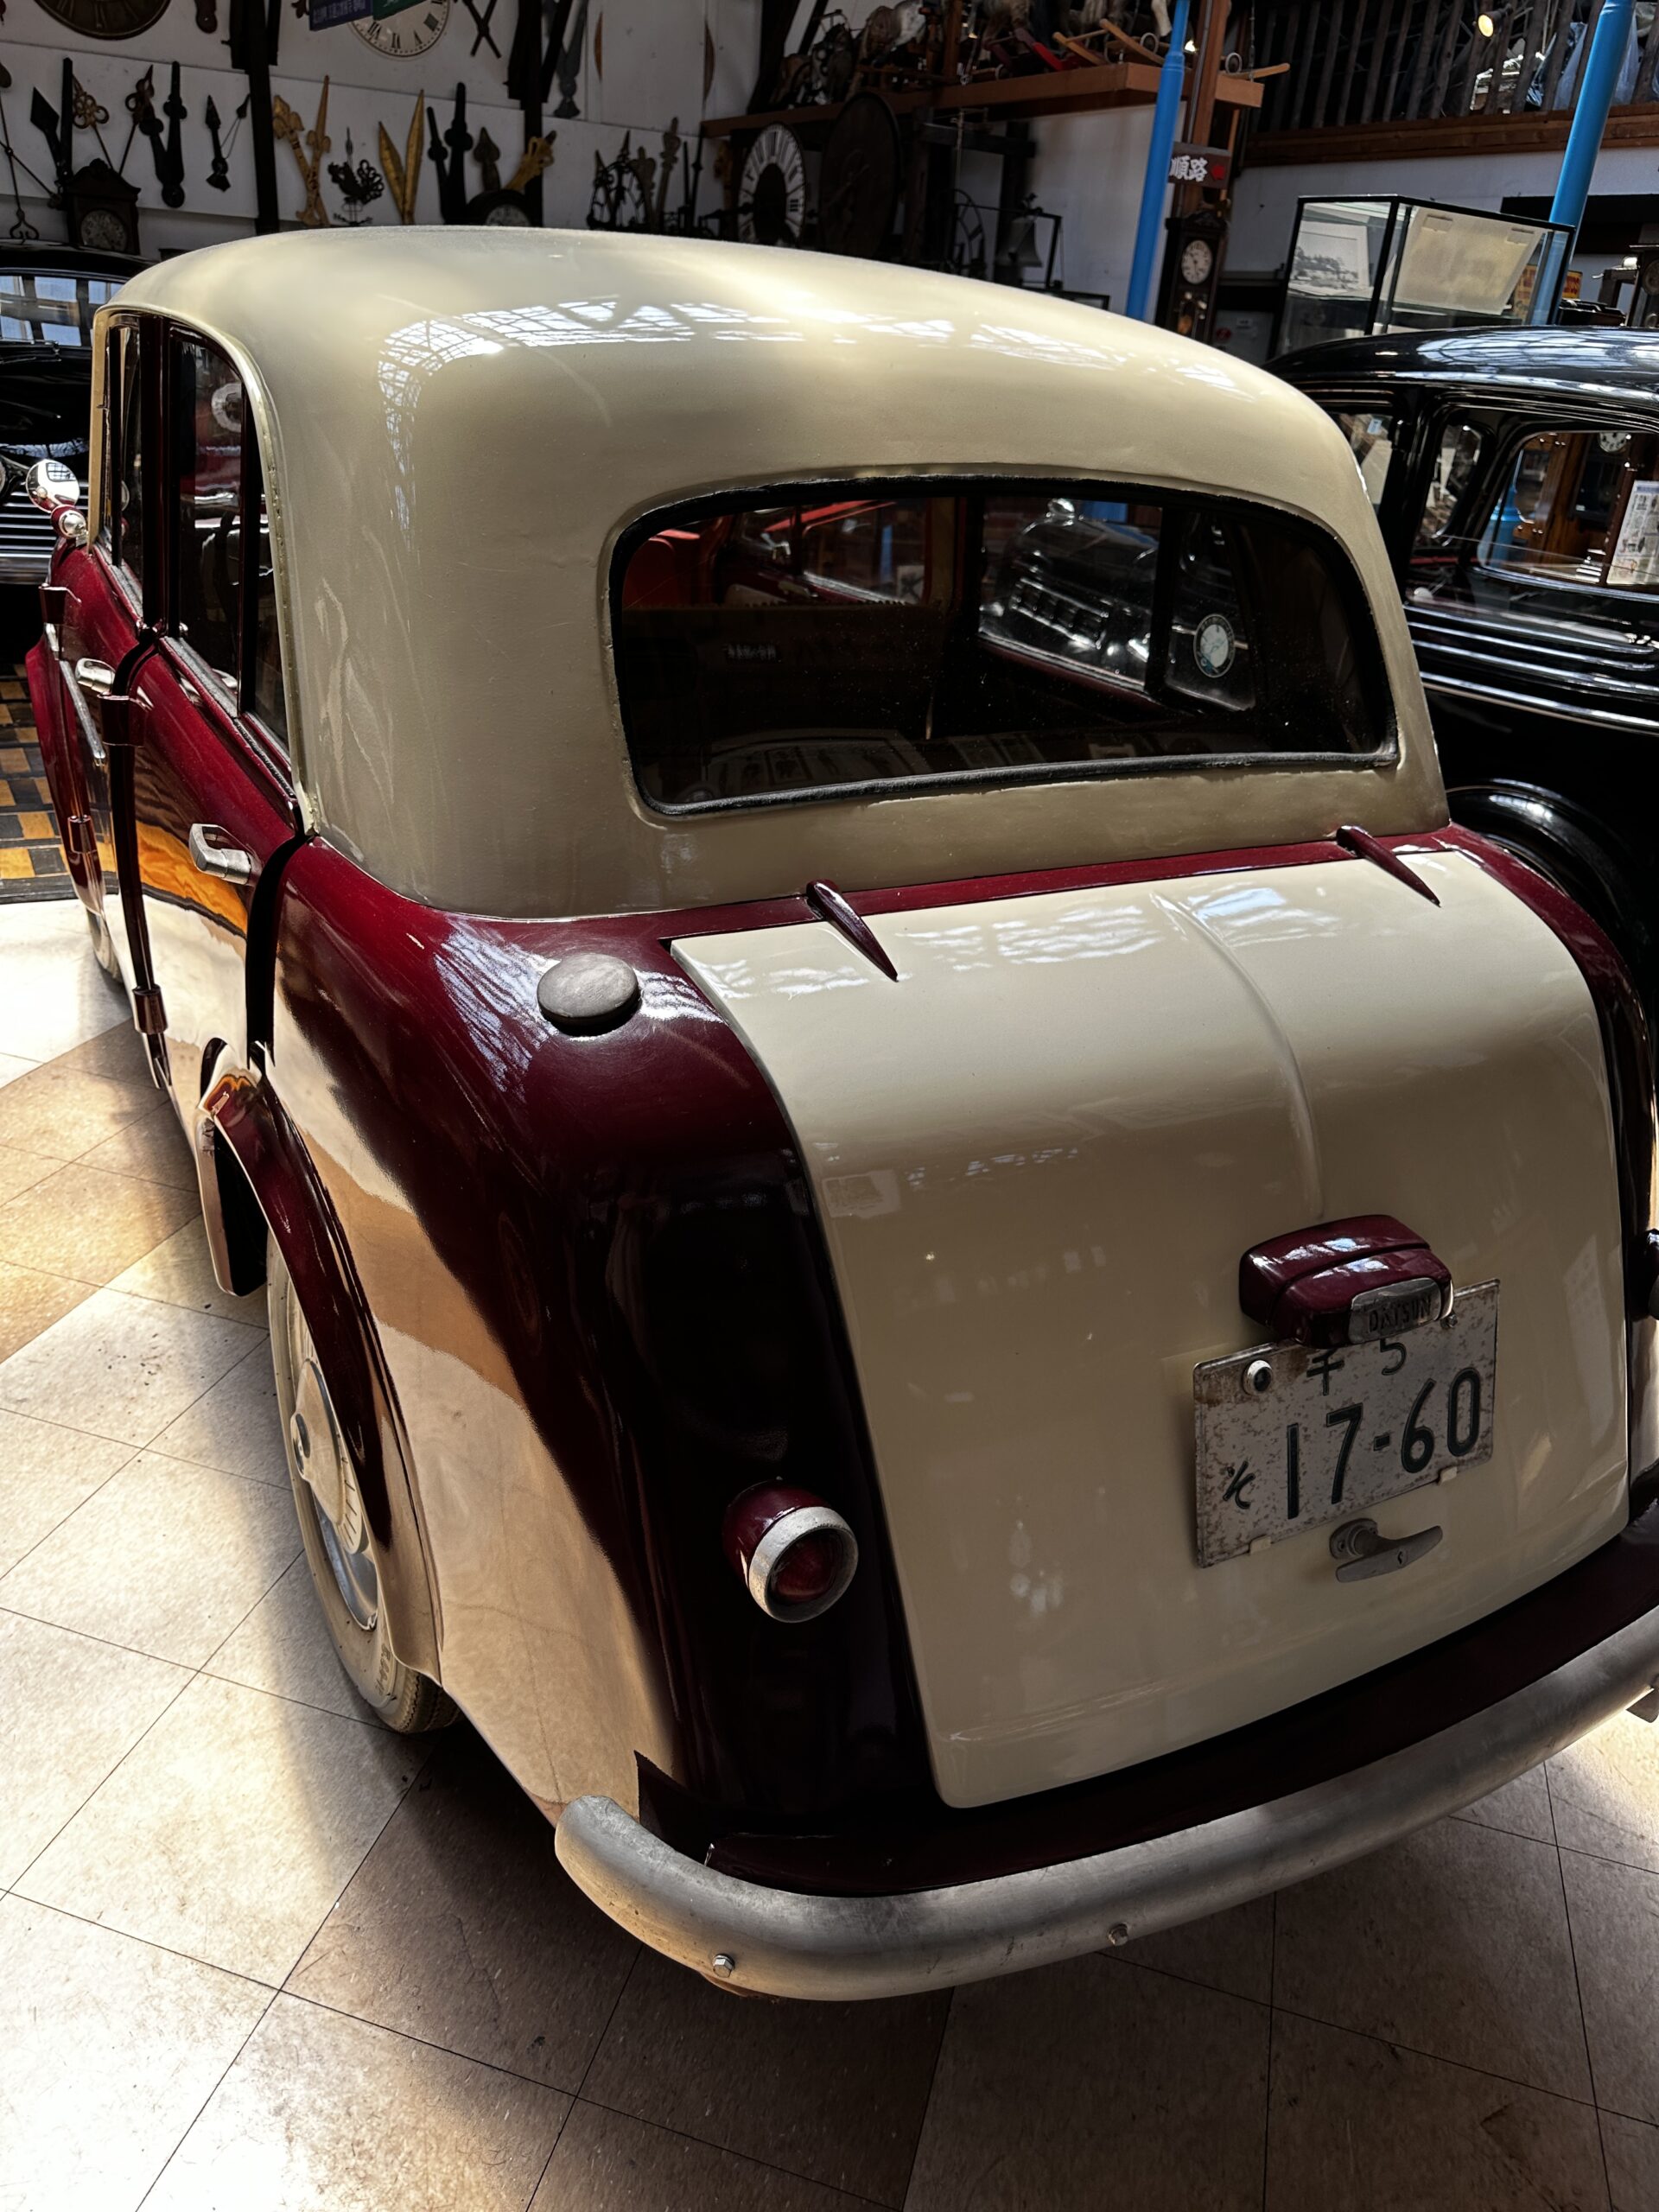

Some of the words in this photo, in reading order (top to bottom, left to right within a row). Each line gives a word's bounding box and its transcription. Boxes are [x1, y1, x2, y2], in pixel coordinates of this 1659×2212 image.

[1367, 1293, 1432, 1333] DATSUN
[1380, 1339, 1407, 1376] 5
[1287, 1367, 1480, 1520] 17-60
